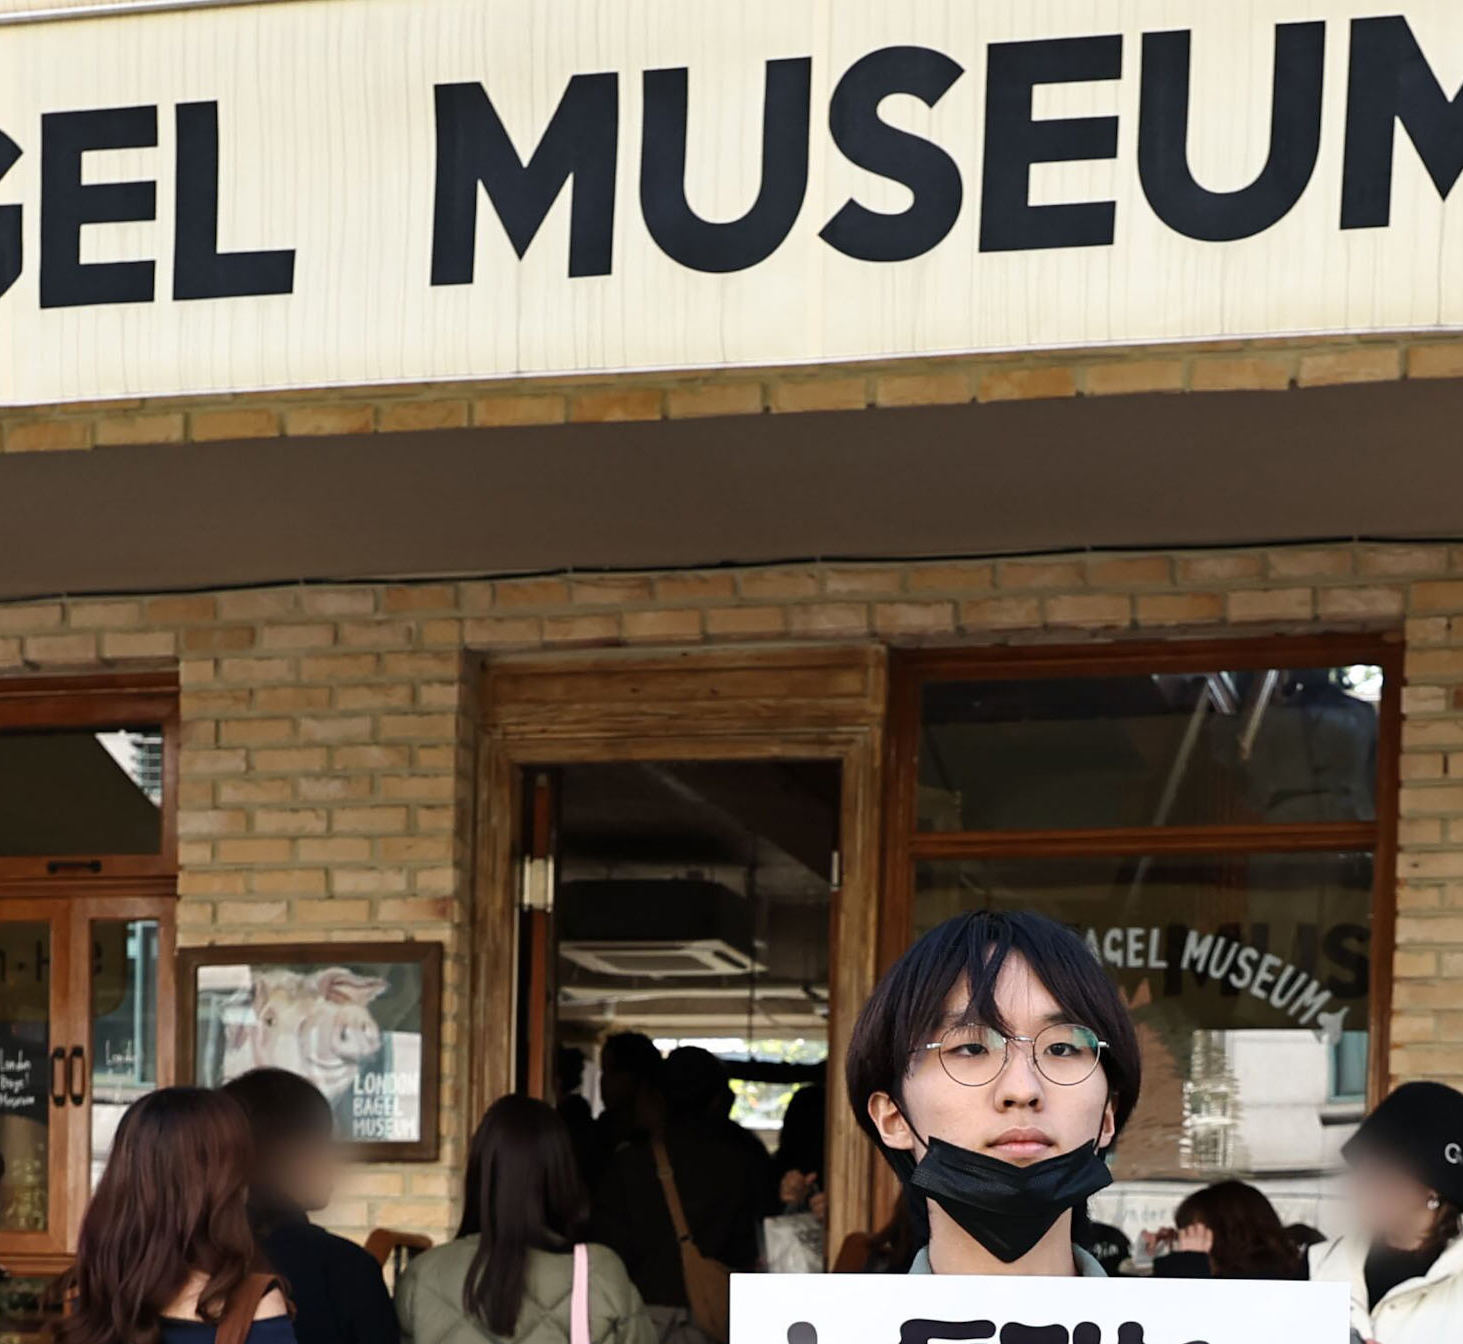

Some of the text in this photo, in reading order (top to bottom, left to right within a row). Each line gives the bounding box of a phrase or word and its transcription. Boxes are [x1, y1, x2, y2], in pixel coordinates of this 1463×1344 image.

[1181, 929, 1332, 1025] MUSEUM
[353, 1072, 419, 1095] LONDON
[353, 1096, 404, 1117] BAGEL
